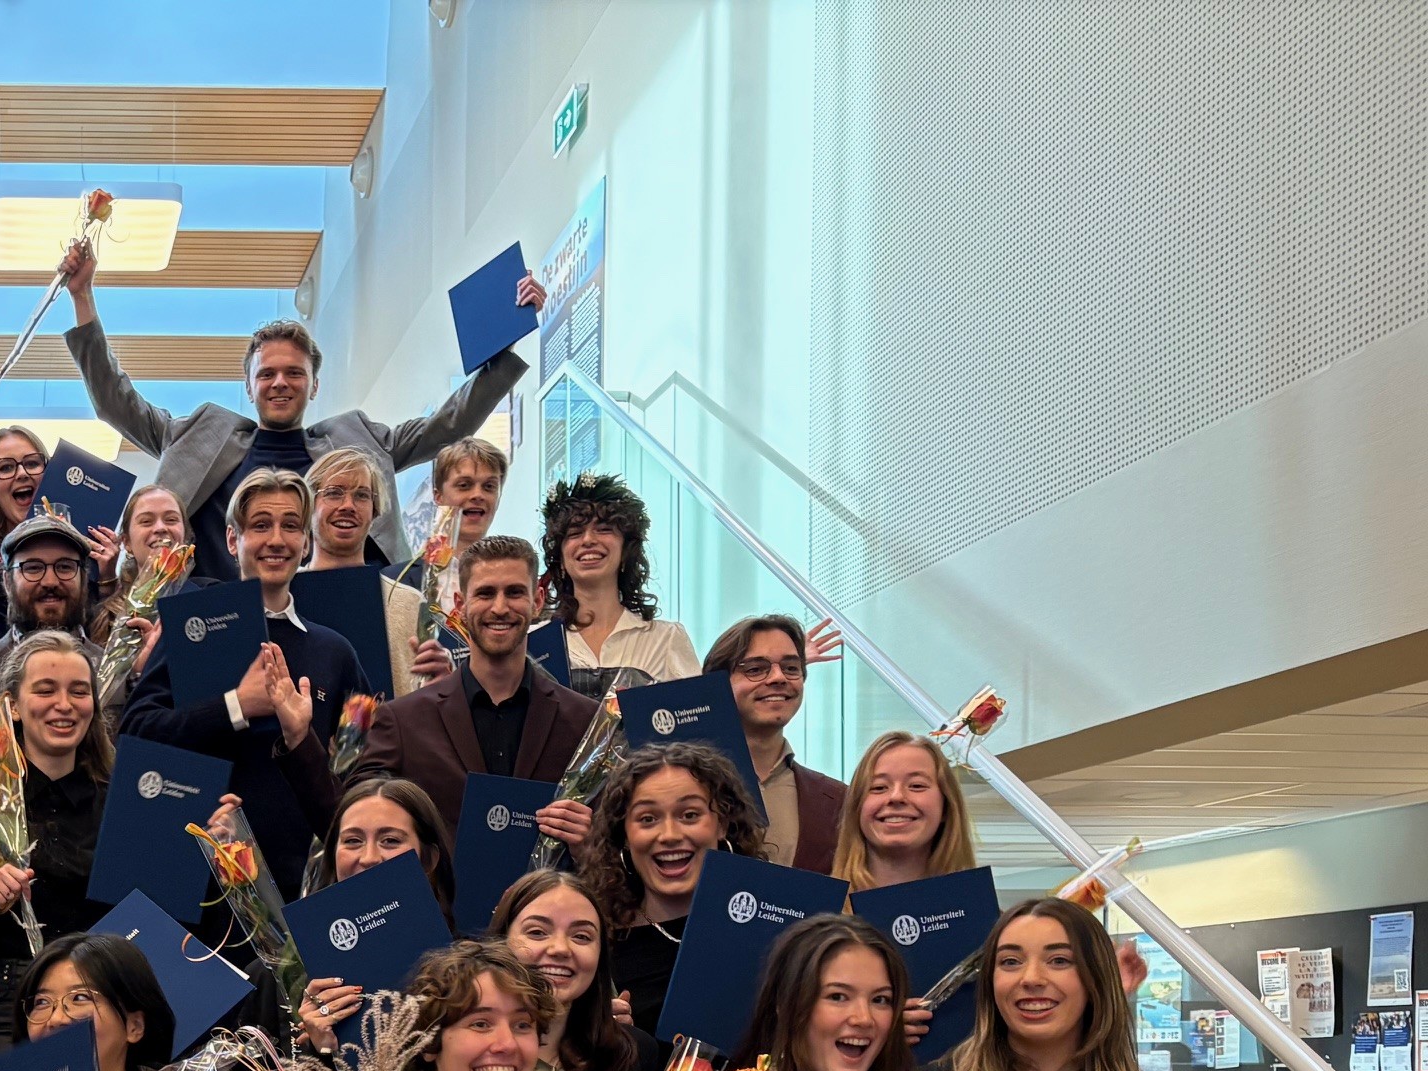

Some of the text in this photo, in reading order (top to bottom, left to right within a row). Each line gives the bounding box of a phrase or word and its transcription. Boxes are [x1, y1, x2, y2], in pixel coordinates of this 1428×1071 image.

[555, 217, 587, 275] zwarte
[674, 705, 711, 717] Universiteit
[677, 714, 699, 725] Leiden
[512, 811, 536, 821] Univers
[510, 819, 532, 828] Leiden
[355, 900, 400, 924] Universiteit
[759, 901, 805, 920] Universiteit
[920, 909, 965, 924] Universiteit
[757, 911, 785, 924] Leiden
[359, 917, 387, 934] Leiden
[922, 921, 950, 933] Leiden
